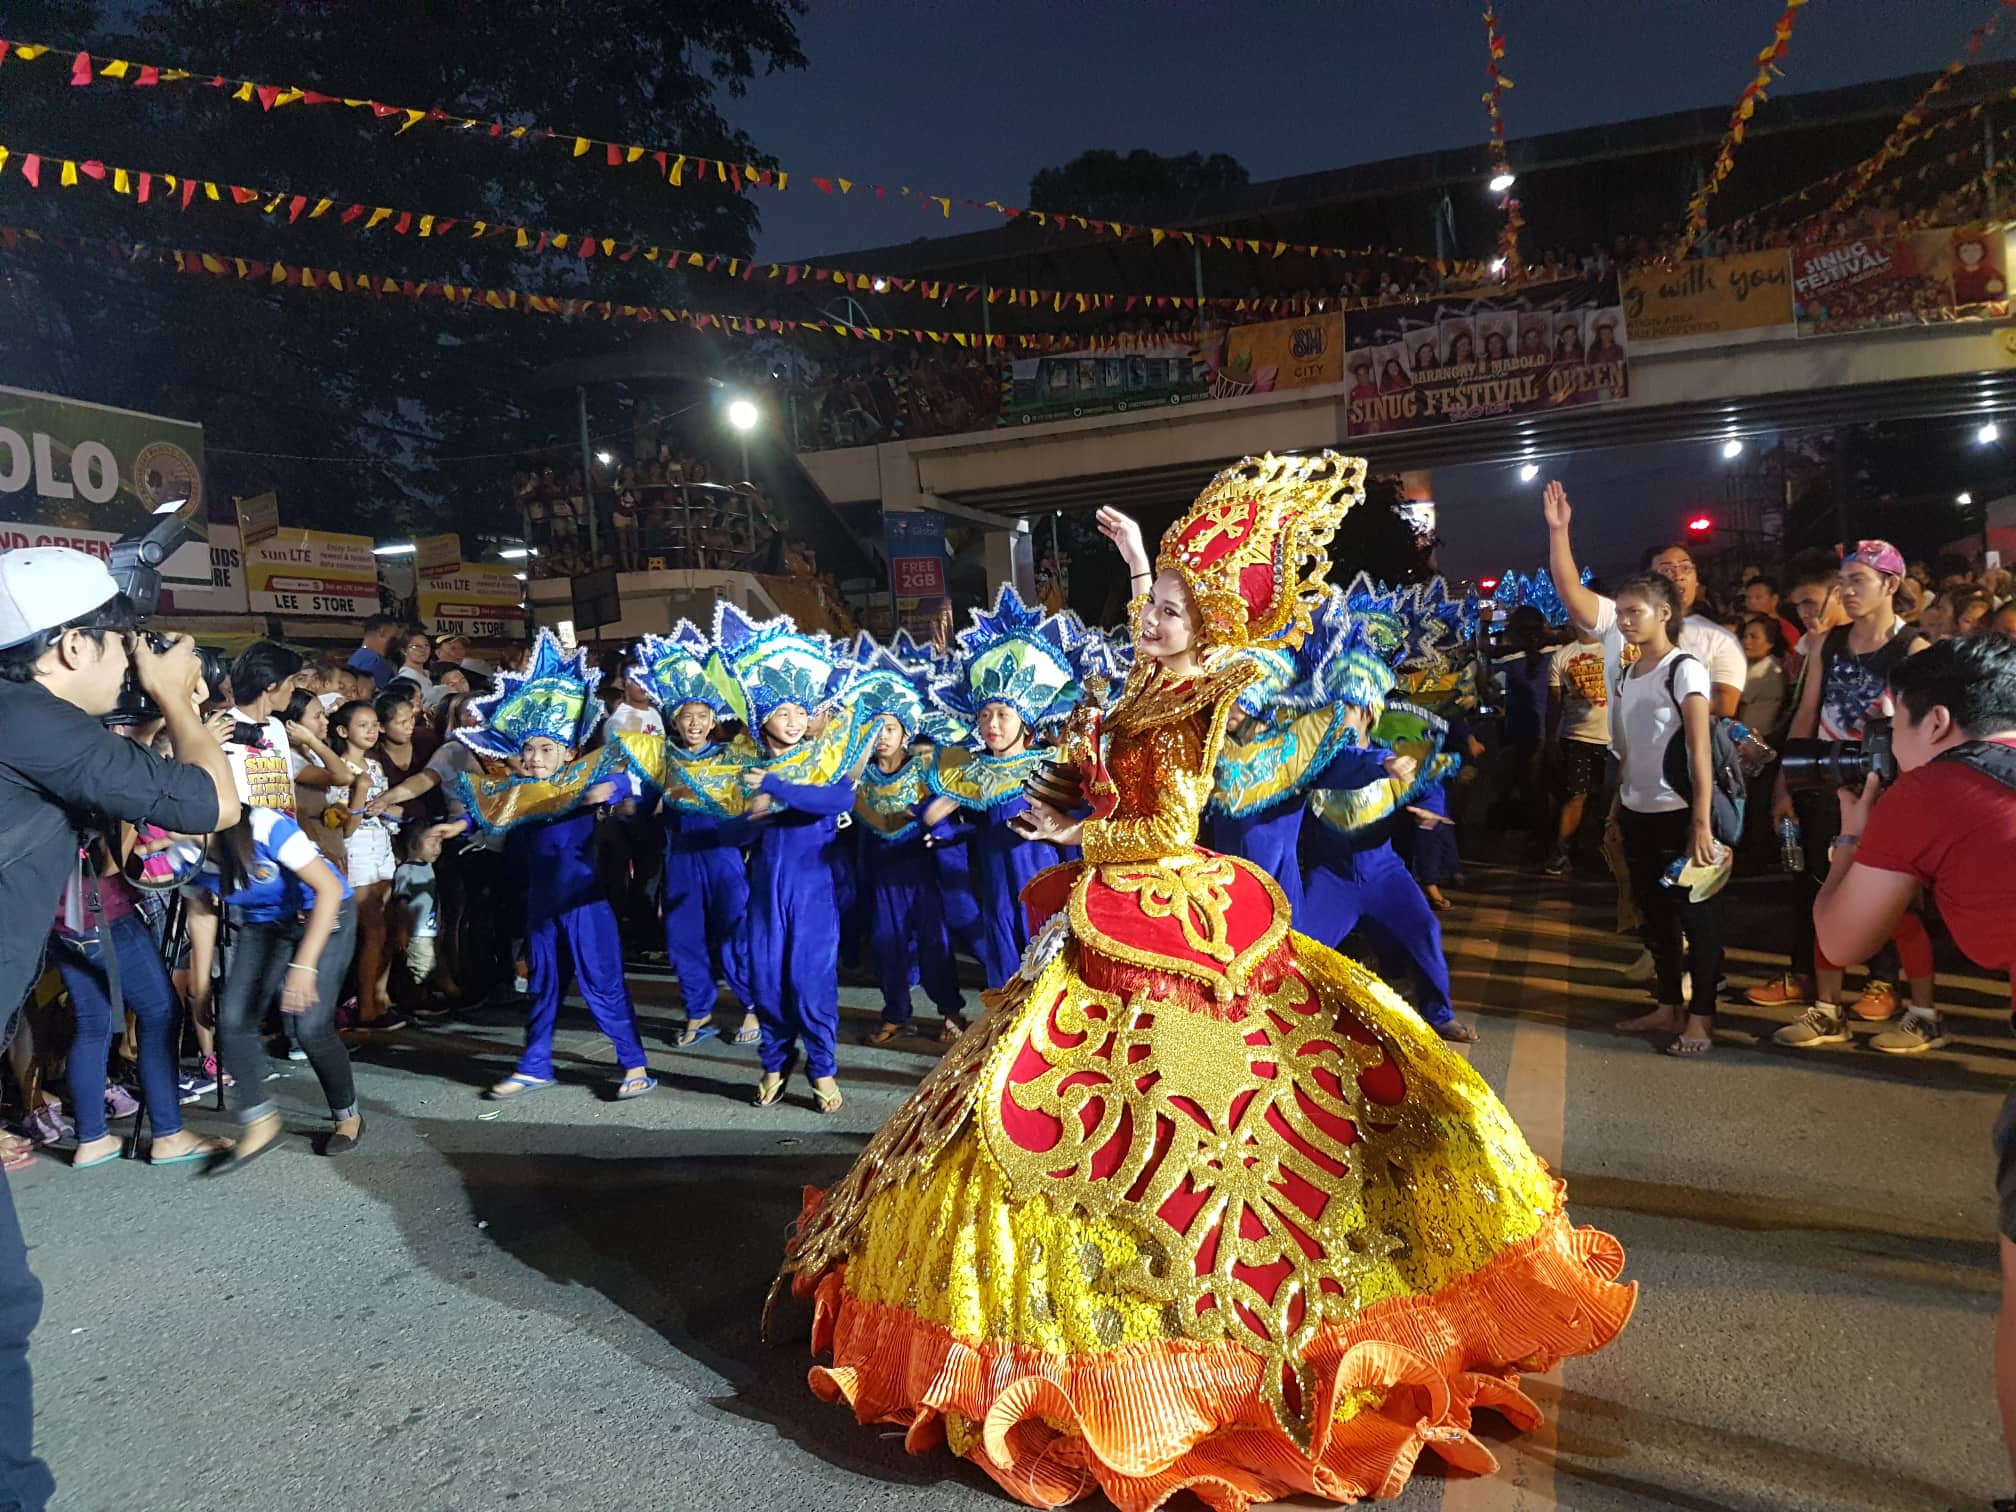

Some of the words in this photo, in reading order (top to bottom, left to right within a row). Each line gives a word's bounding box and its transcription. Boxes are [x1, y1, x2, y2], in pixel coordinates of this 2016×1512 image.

[1804, 241, 1868, 274] SINUG
[1795, 248, 1890, 292] FESTIVAL
[1659, 264, 1715, 298] with
[1294, 364, 1324, 377] CITY
[1410, 363, 1476, 384] BARANGAY
[1491, 354, 1545, 373] MABOLO
[1351, 392, 1418, 424] SINUG
[1423, 375, 1540, 416] FESTIVAL
[1546, 361, 1625, 399] QUEEN
[290, 548, 312, 563] LTE
[902, 561, 935, 573] FREE
[454, 579, 471, 591] LTE
[902, 574, 936, 588] 2GB
[275, 595, 299, 609] LEE
[312, 597, 355, 612] STORE
[473, 621, 505, 635] STORE
